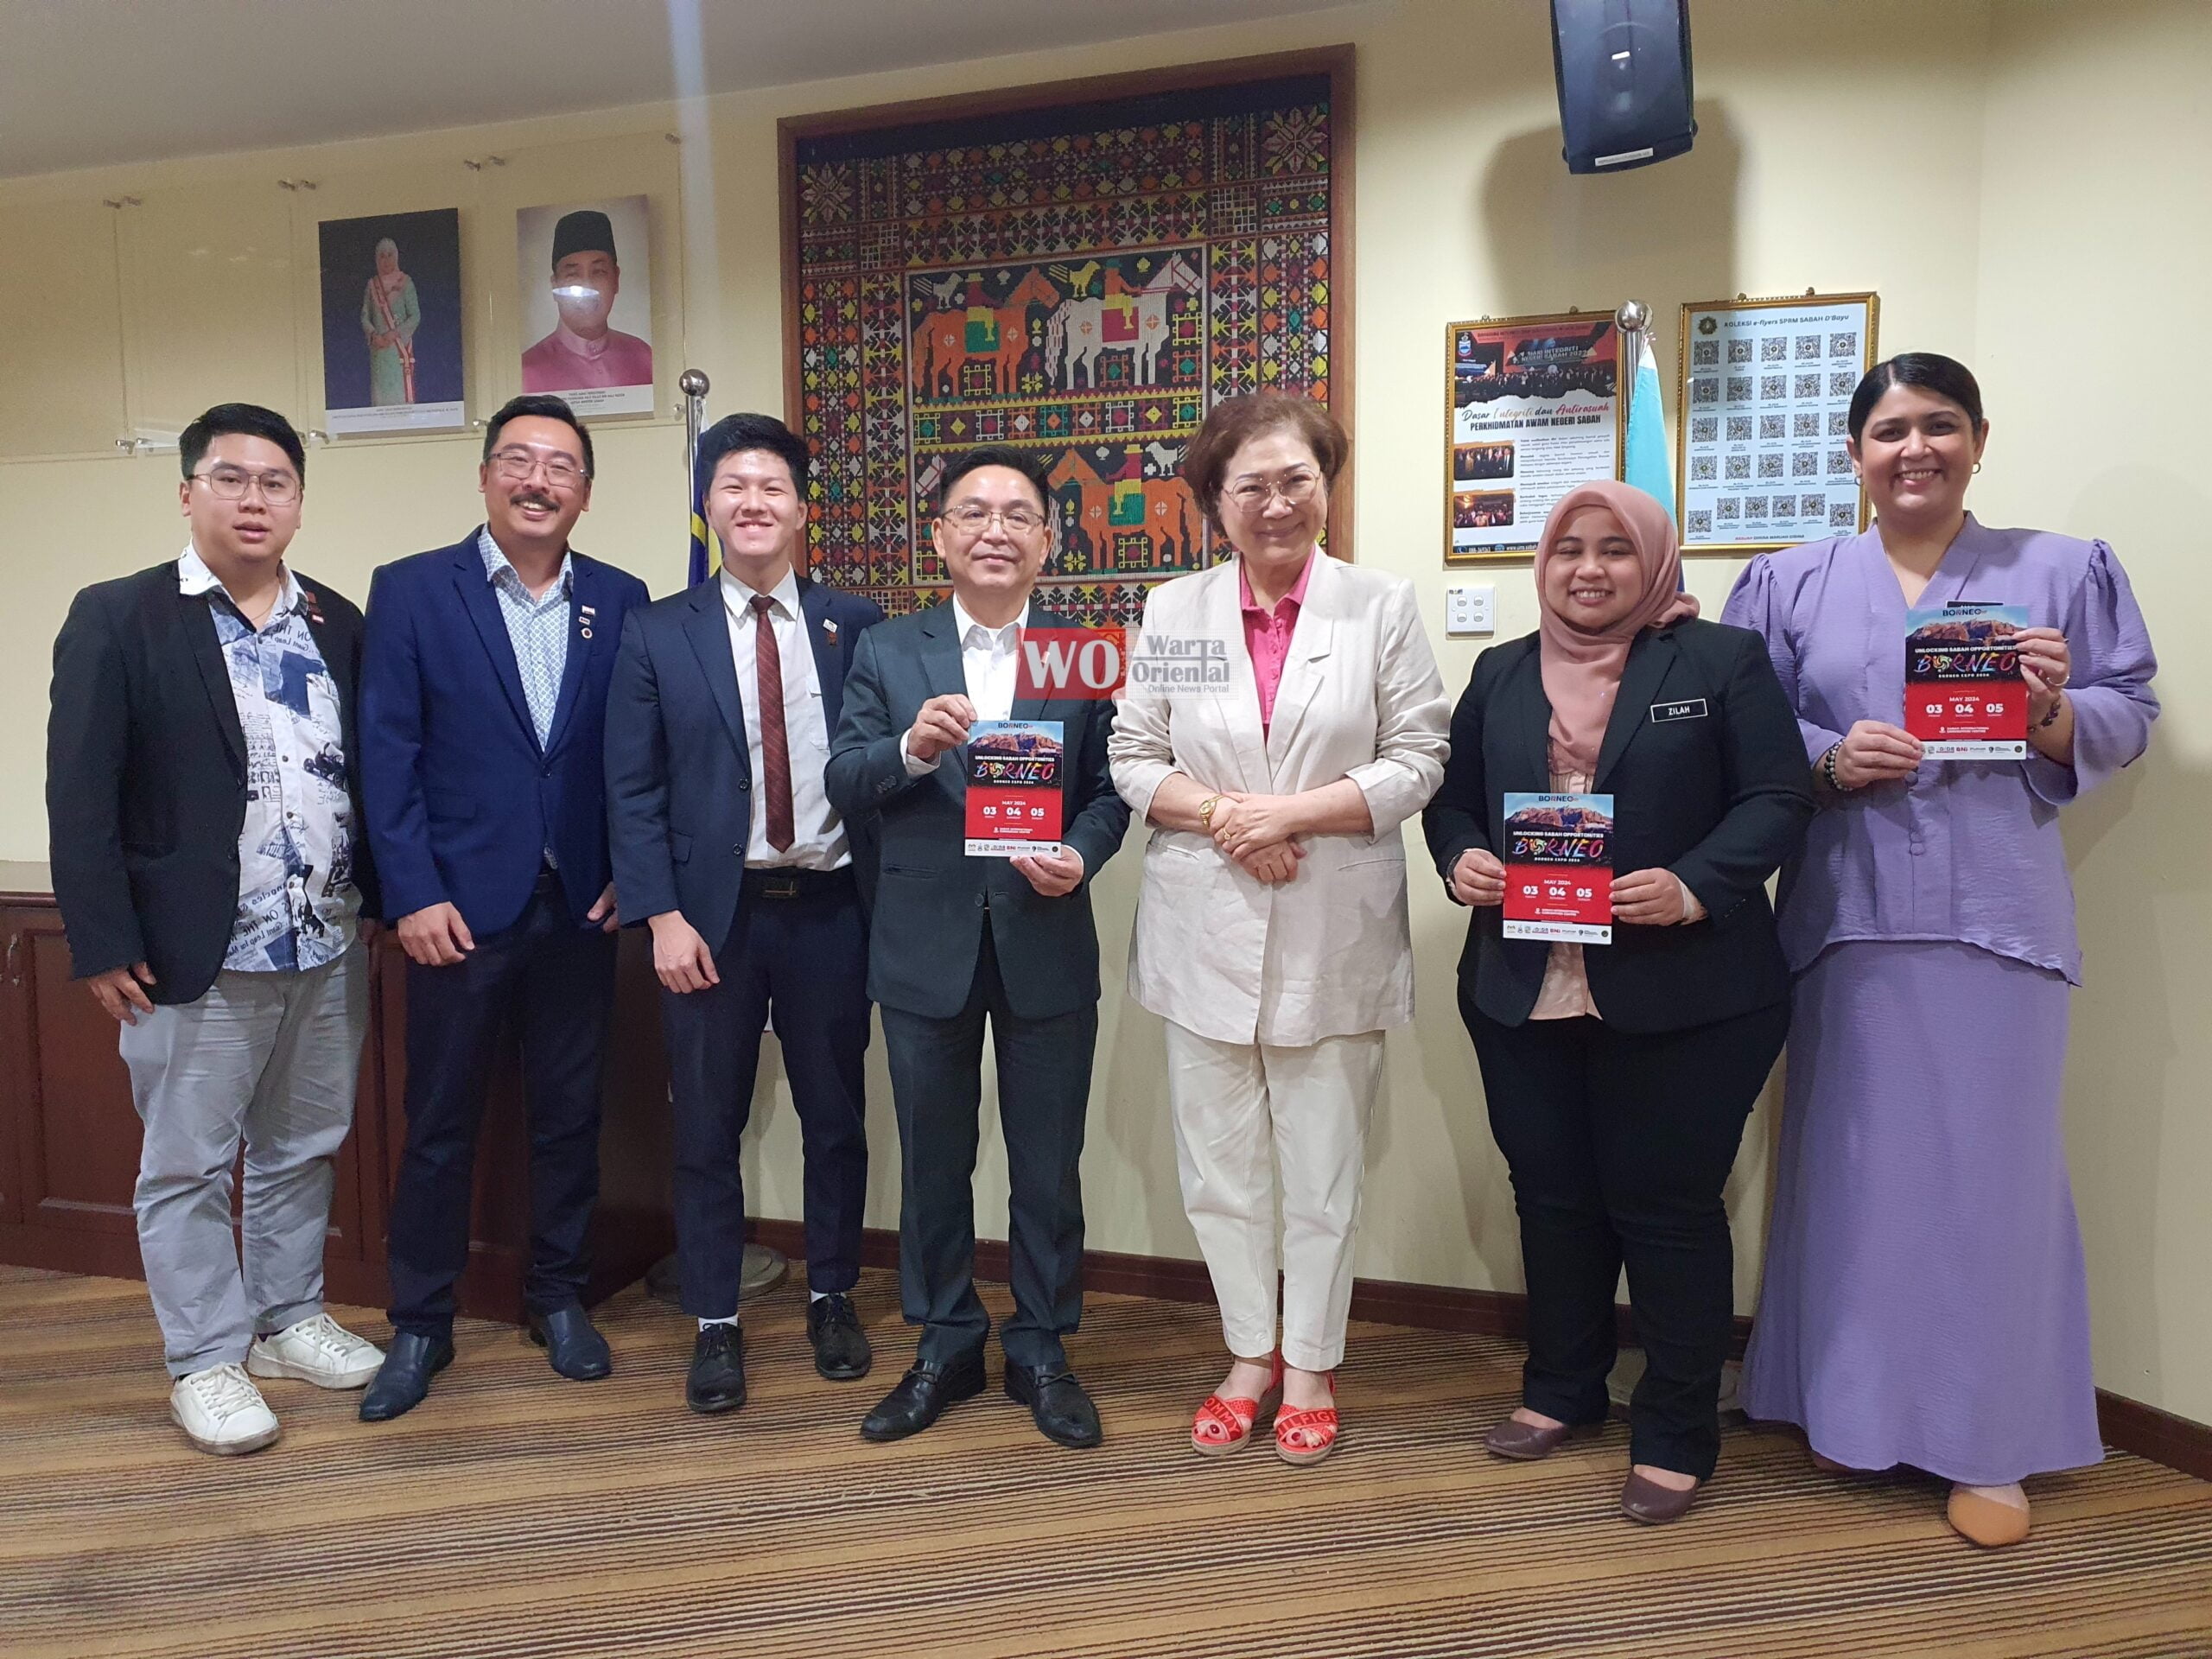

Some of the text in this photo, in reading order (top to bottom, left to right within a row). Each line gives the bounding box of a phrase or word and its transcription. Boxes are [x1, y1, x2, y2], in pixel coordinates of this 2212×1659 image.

[1462, 410, 1490, 421] Dasar
[1535, 406, 1553, 416] dan
[1555, 402, 1609, 416] Antirasuah
[1471, 415, 1601, 431] PERKHIDMATAN AWAM NEGERI SABAH
[1942, 608, 1981, 617] BORNEO
[1913, 652, 2017, 673] BORNEO
[1669, 705, 1690, 716] ZILAH
[1926, 703, 2004, 714] 03 04 05
[974, 761, 1055, 780] BORNEO
[983, 806, 1045, 817] 03 04 05
[1512, 837, 1605, 858] BORNEO
[1522, 886, 1592, 898] 03 04 05
[1205, 1397, 1240, 1433] OMMY
[1278, 1411, 1338, 1436] ILFIGE
